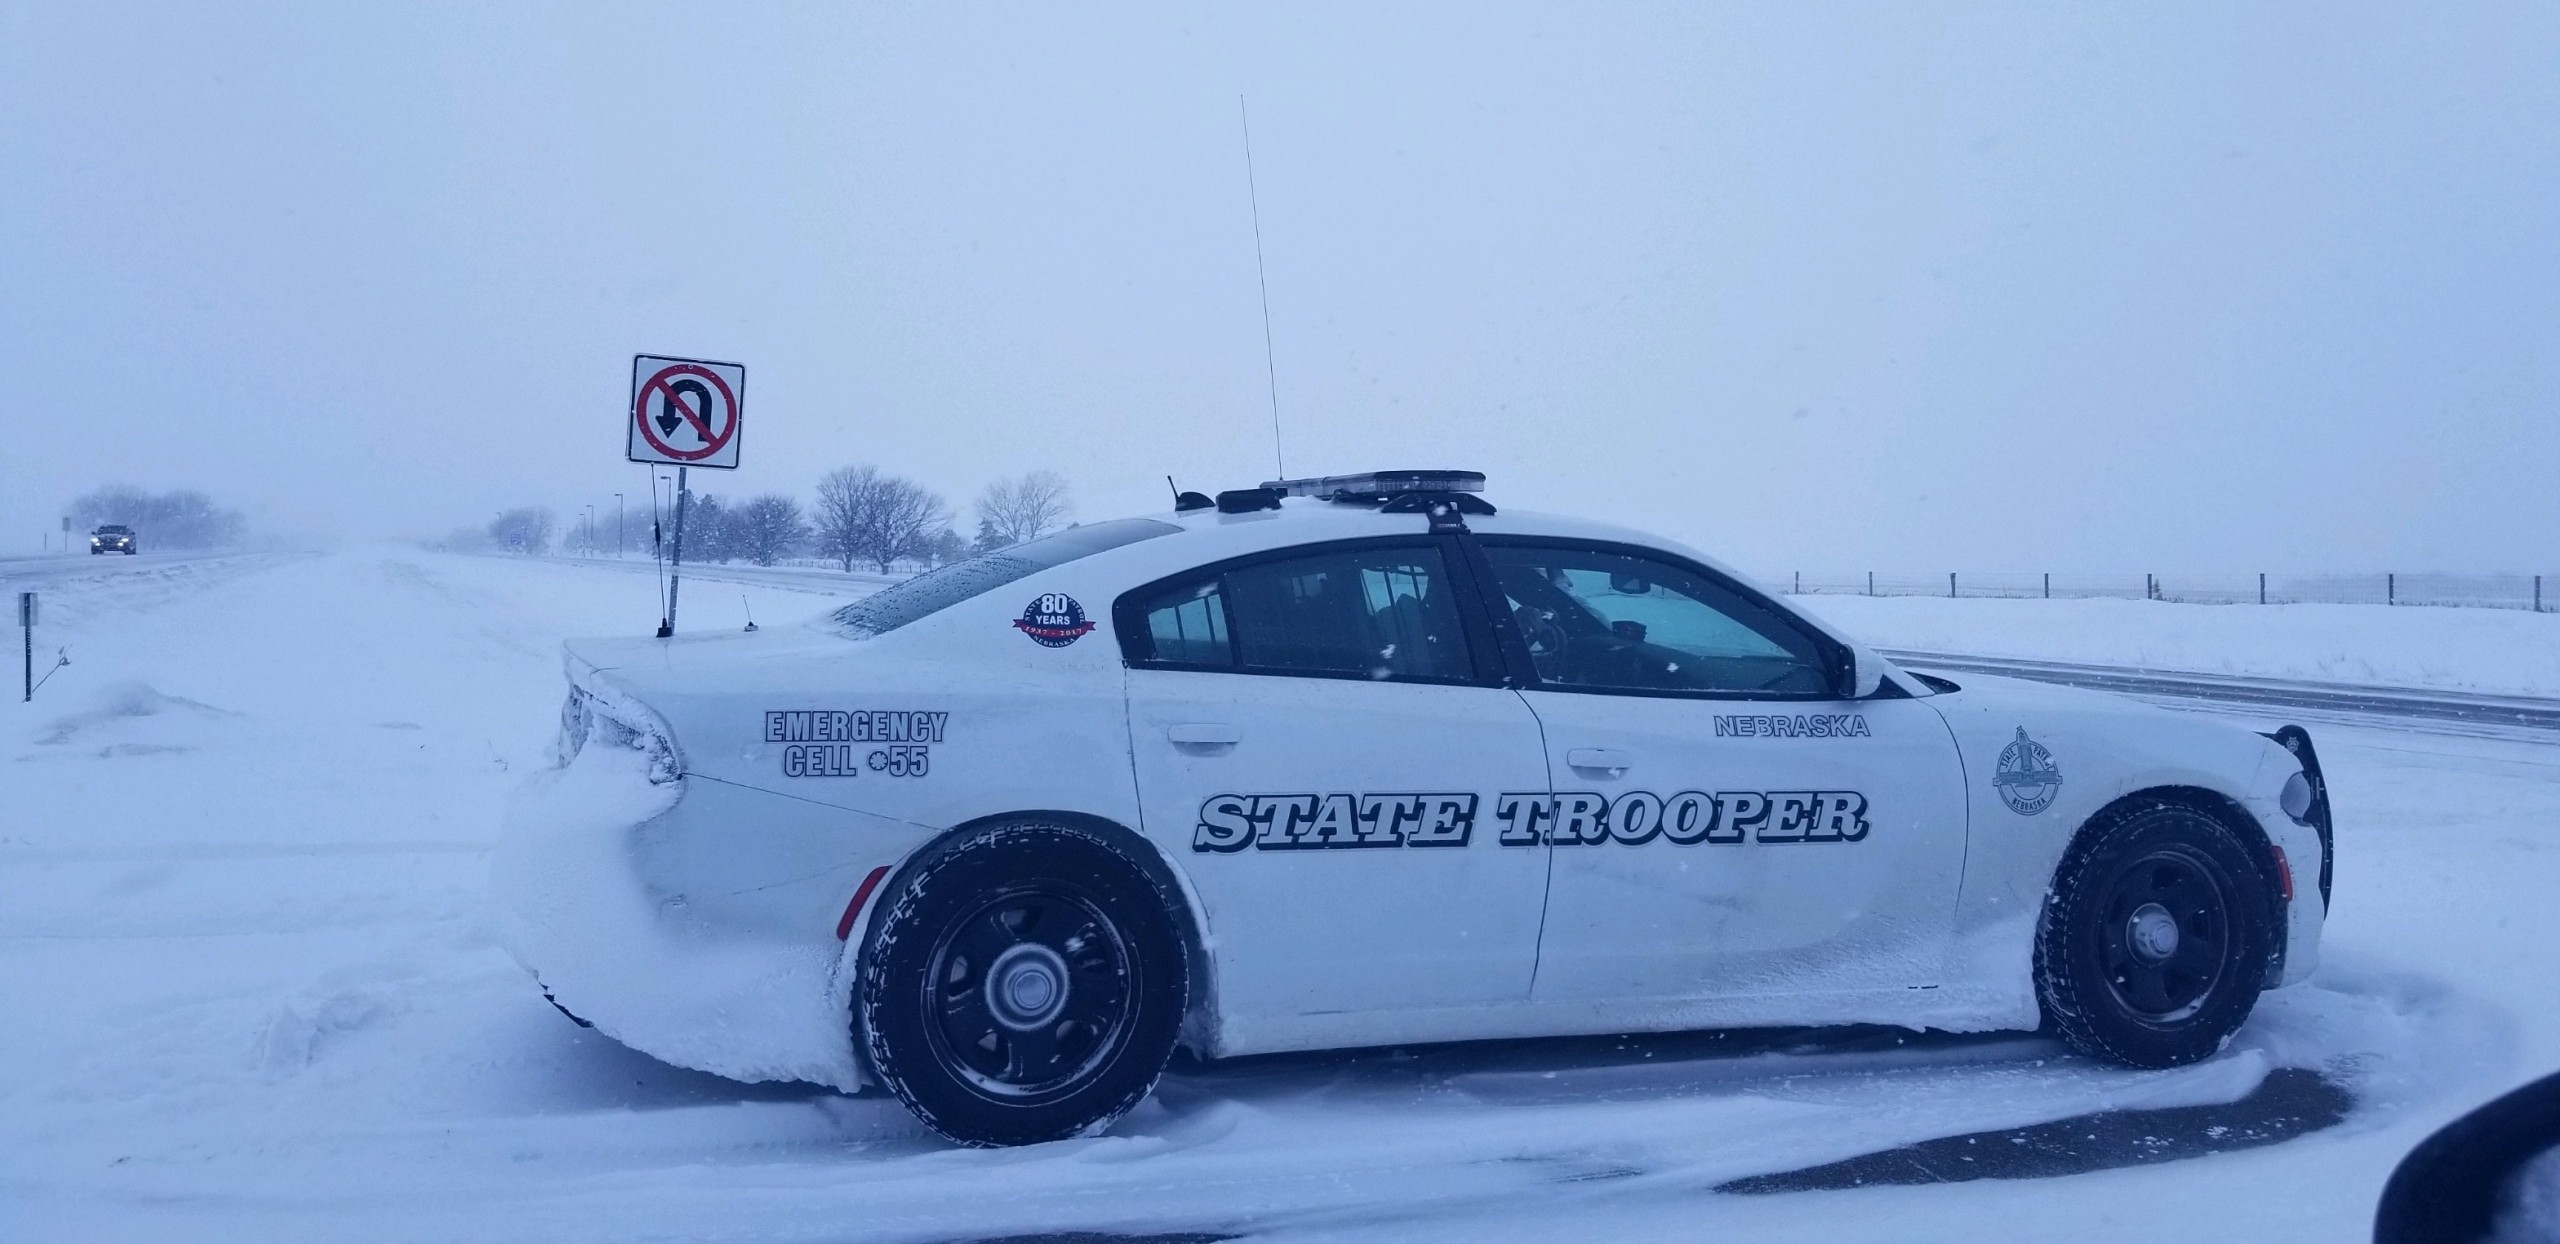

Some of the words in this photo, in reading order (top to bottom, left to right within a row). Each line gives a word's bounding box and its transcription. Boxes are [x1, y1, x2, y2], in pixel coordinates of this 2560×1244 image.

[1024, 599, 1041, 621] STATE
[1068, 598, 1085, 623] PATROL
[1041, 594, 1068, 614] 80
[1025, 626, 1047, 635] 1937
[1060, 628, 1082, 636] 2017
[1035, 615, 1071, 625] YEARS
[1033, 635, 1076, 647] NEBRASKA
[765, 711, 949, 742] EMERGENCY
[1714, 714, 1871, 737] NEBRASKA
[784, 745, 857, 777] CELL
[2000, 747, 2017, 769] STATE
[2011, 797, 2047, 811] NEBRASKA
[1192, 793, 1479, 853] STATE
[1496, 790, 1871, 846] TROOPER
